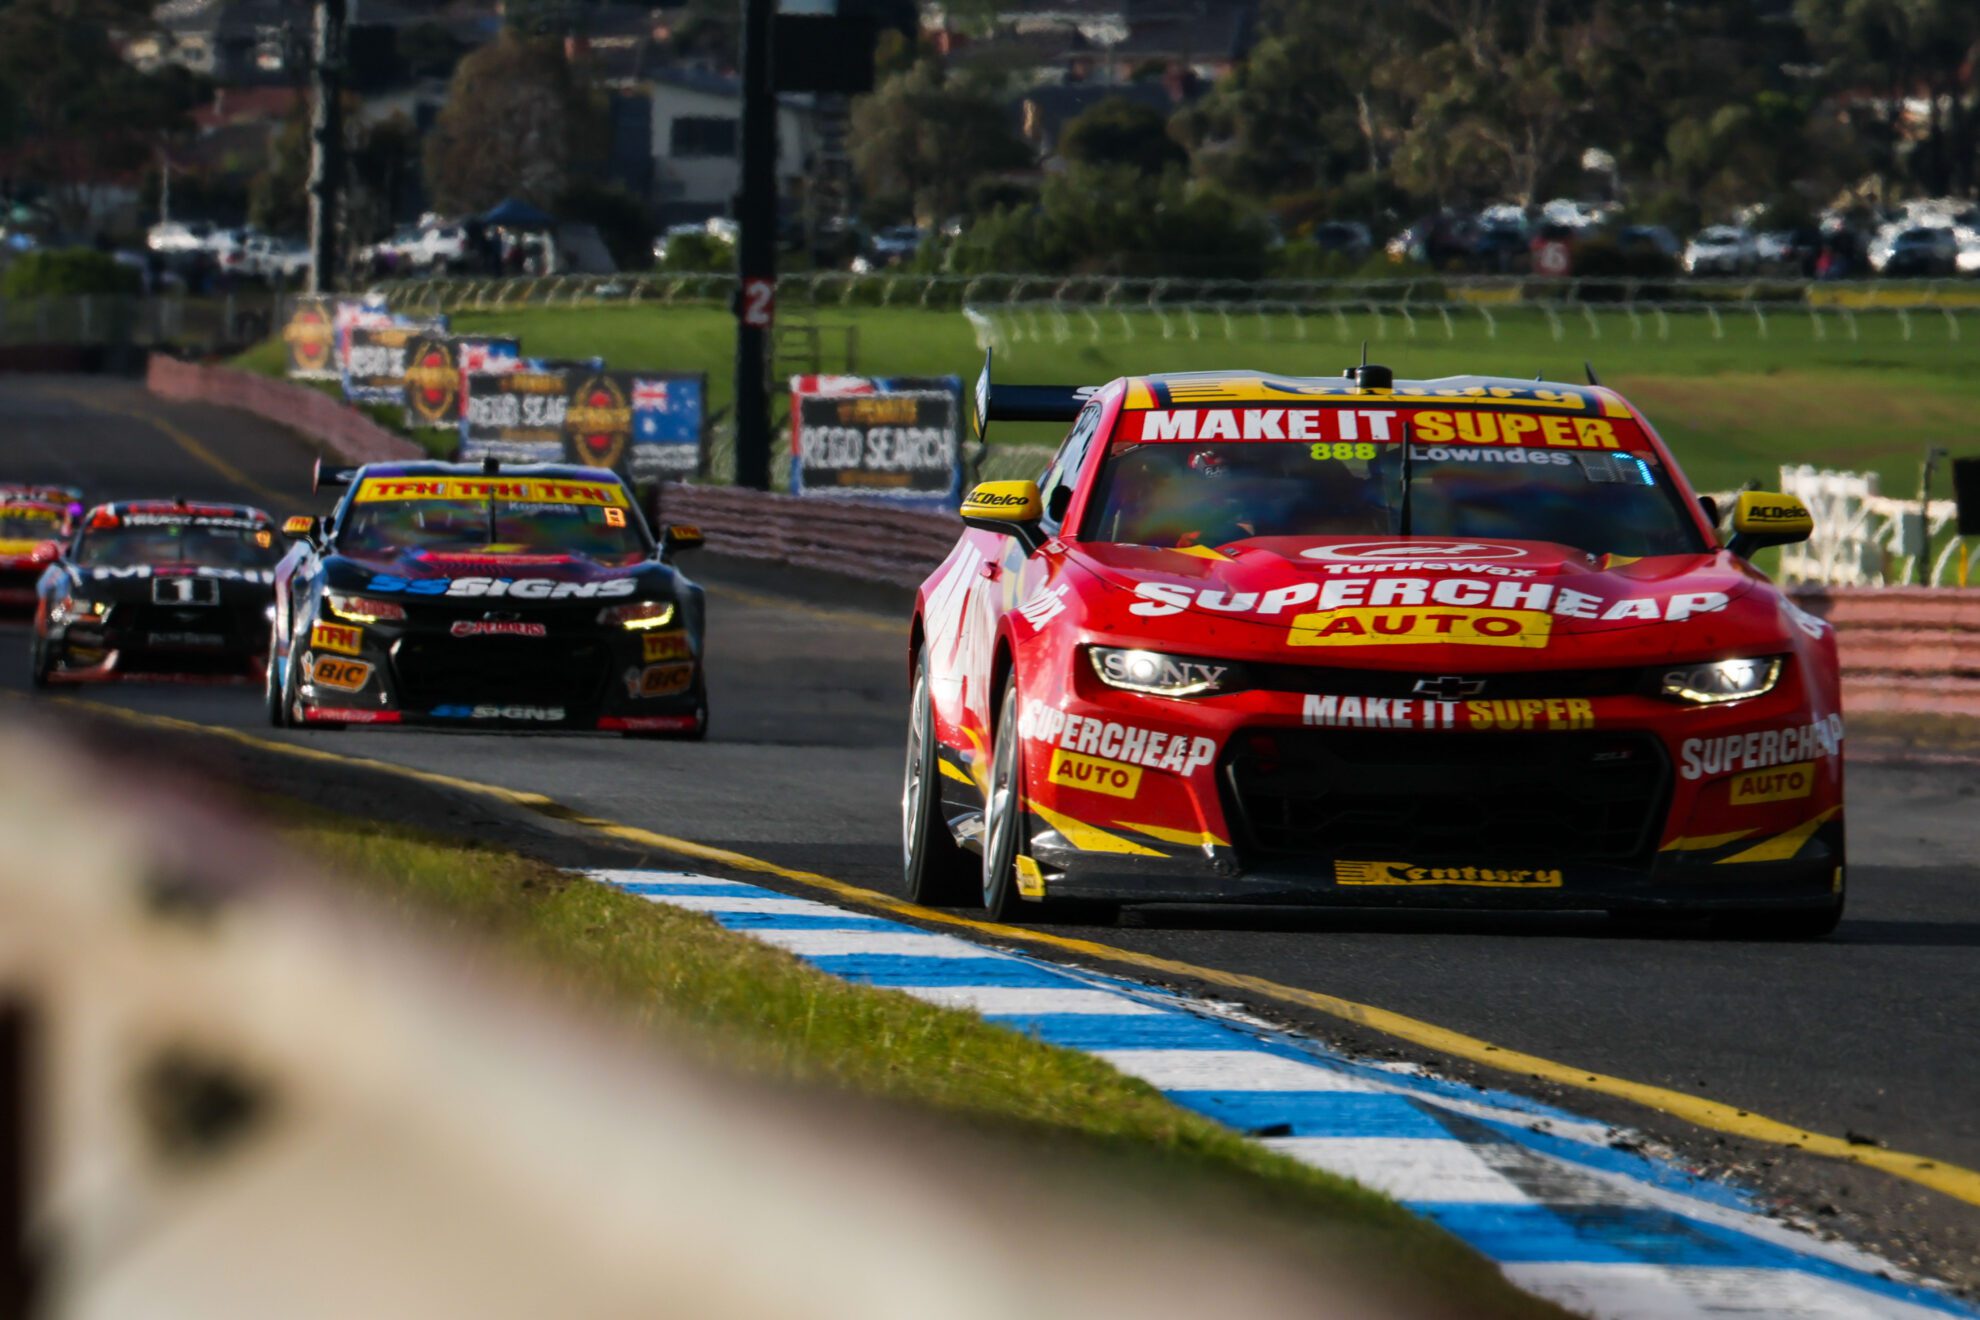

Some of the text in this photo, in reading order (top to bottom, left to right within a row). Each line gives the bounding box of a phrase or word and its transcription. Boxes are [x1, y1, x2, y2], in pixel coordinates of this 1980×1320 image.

[1541, 241, 1568, 272] 6
[746, 280, 771, 324] 2
[1141, 409, 1620, 448] MAKE IT SUPER
[802, 425, 956, 470] REGO SEARCH
[1310, 443, 1377, 460] 888
[1409, 445, 1572, 467] Lowndes
[375, 482, 439, 496] TFH
[457, 482, 521, 497] TFH
[538, 484, 607, 502] TFH
[966, 491, 1029, 506] ACDelco
[1749, 505, 1810, 518] ACDelc
[171, 578, 194, 602] 1
[1129, 578, 1730, 622] SUPERCHEAP
[318, 625, 354, 648] TFH
[1316, 614, 1522, 638] AUTO
[1104, 653, 1228, 690] SONY
[1302, 694, 1596, 730] MAKE IT SUPER
[1017, 698, 1217, 777] SUPERCHEAP
[1680, 713, 1844, 781] SUPERCHEAP
[1056, 759, 1129, 788] AUTO
[1738, 771, 1805, 797] AUTO
[1362, 860, 1564, 888] Century
